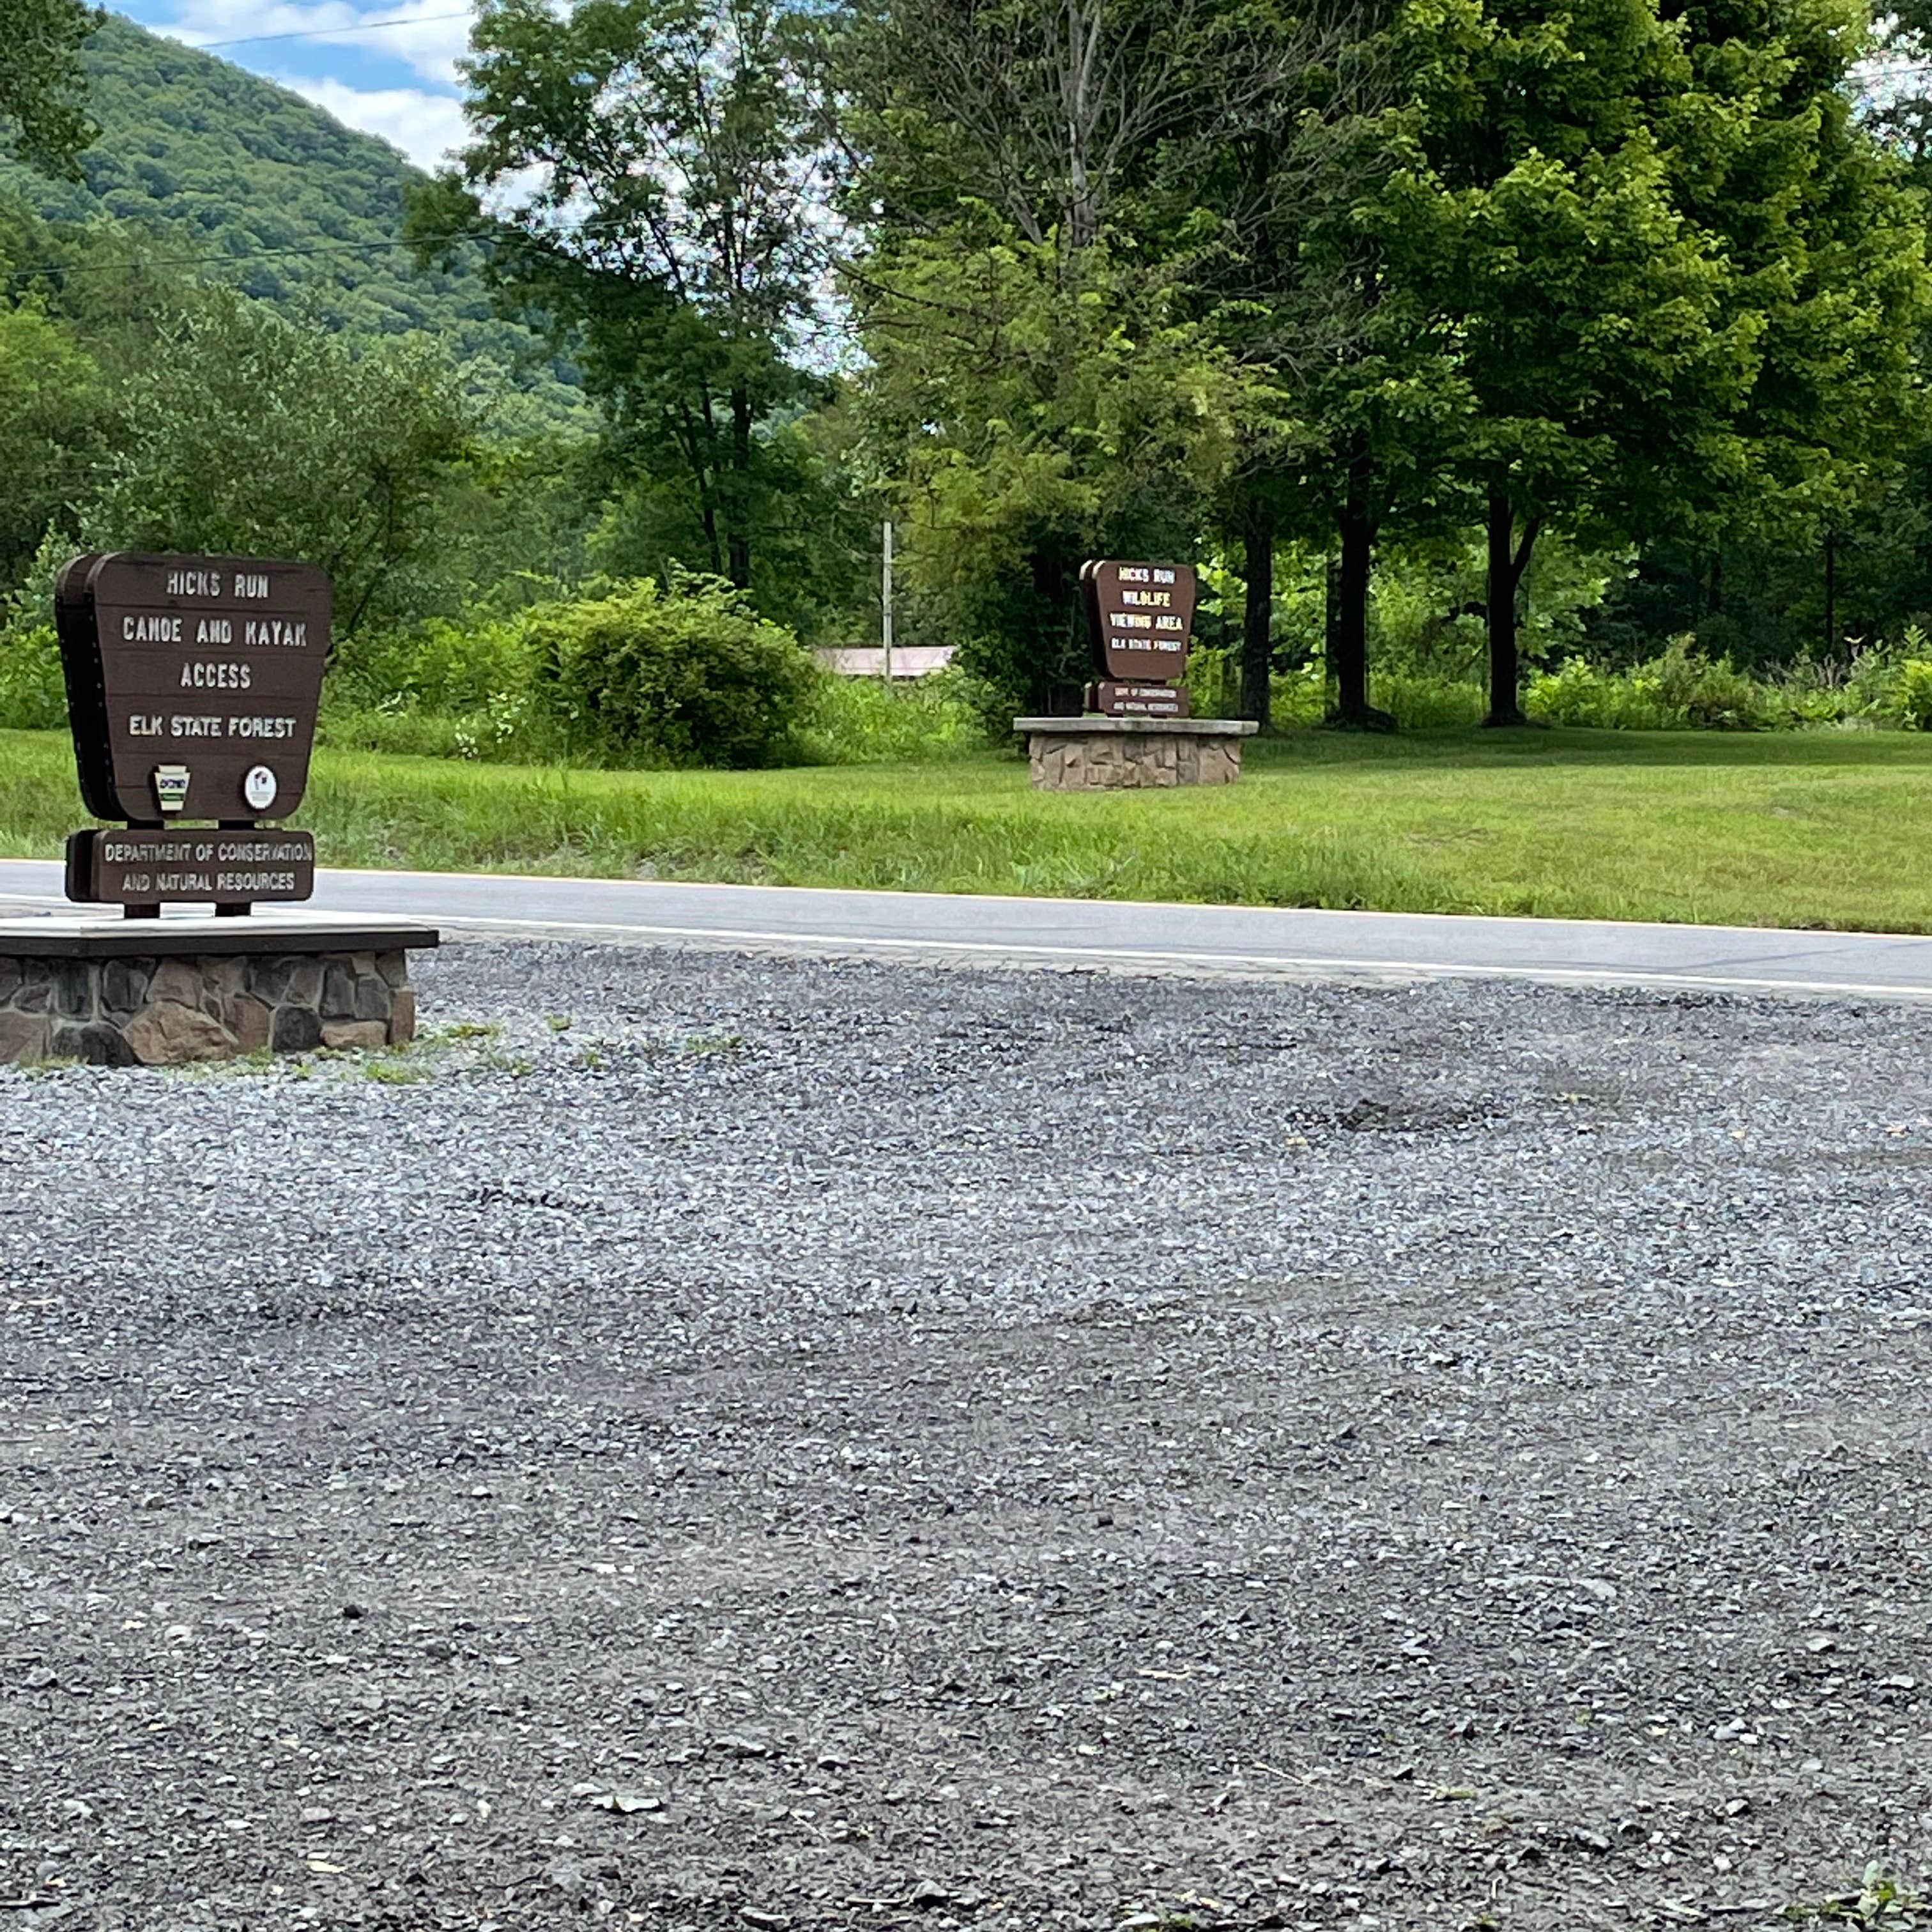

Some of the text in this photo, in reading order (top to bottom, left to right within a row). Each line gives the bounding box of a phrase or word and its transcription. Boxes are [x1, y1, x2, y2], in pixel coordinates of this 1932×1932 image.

[167, 572, 268, 597] HICKS RUN
[123, 617, 307, 646] CANOE AND KAYAK
[180, 663, 251, 688] ACCESS
[130, 715, 296, 737] ELK STATE FOREST
[105, 843, 312, 861] DEPARTMENT OF CONSERVATION
[122, 872, 295, 891] AND NATURAL RESOURCES
